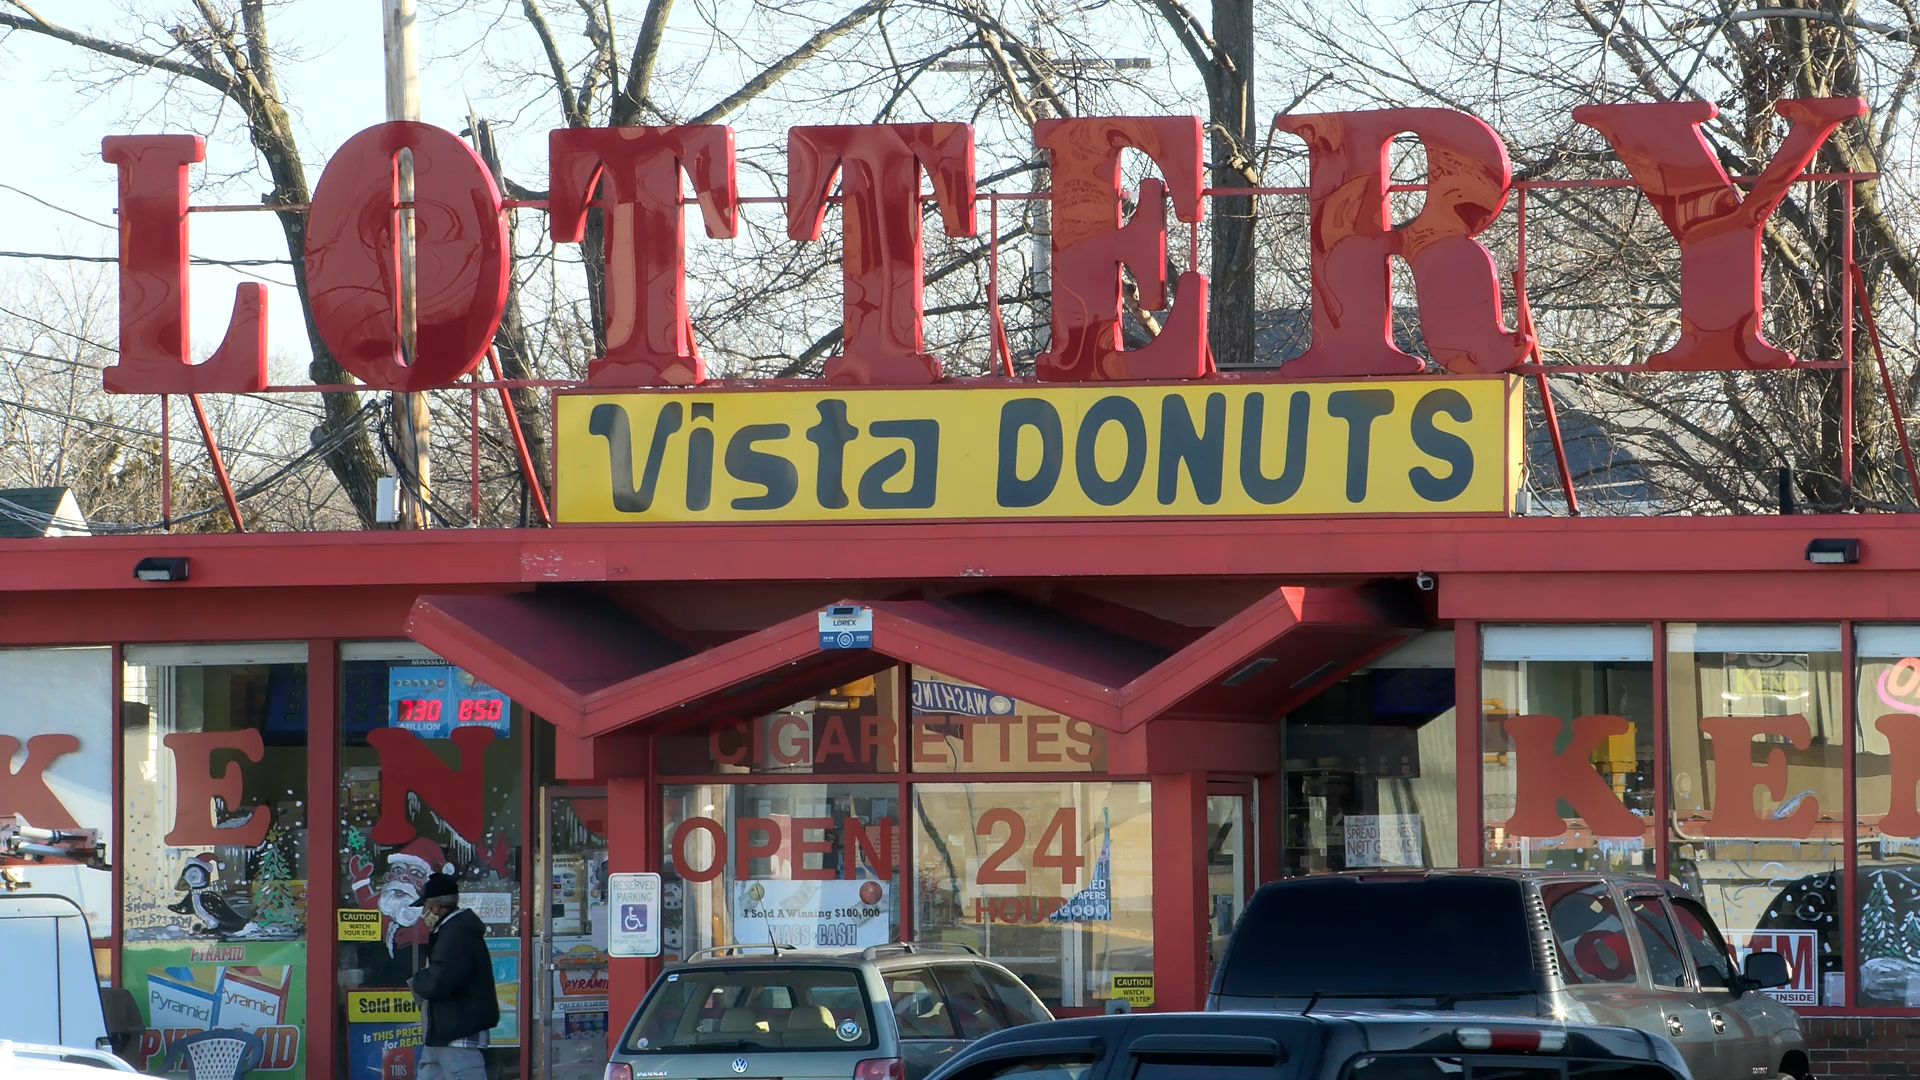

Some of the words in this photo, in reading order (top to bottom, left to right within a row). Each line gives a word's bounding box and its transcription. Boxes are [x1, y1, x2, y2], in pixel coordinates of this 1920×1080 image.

[101, 97, 1869, 394] LOTTERY
[589, 399, 940, 513] Vista
[998, 387, 1475, 508] DONUTS
[1735, 668, 1799, 694] KENO
[402, 700, 442, 721] 730
[458, 700, 502, 721] 850
[708, 715, 1099, 764] CIGARETTES
[1347, 828, 1376, 839] SPREAD
[672, 817, 892, 882] OPEN
[976, 807, 1085, 884] 24
[1347, 841, 1371, 855] NOT
[613, 881, 656, 891] RESERVED
[617, 893, 652, 902] PARKING
[743, 909, 749, 918] I
[751, 909, 775, 918] Sold
[777, 909, 785, 918] A
[788, 908, 831, 920] Winning
[834, 908, 880, 919] $100,000
[190, 945, 246, 962] PYRAMID
[151, 990, 210, 1022] Pyramid
[359, 998, 390, 1013] Sold
[373, 1030, 394, 1041] THIS
[396, 1026, 423, 1038] PRICE
[384, 1041, 398, 1050] for
[400, 1037, 423, 1047] REAL
[390, 1064, 407, 1076] THIS
